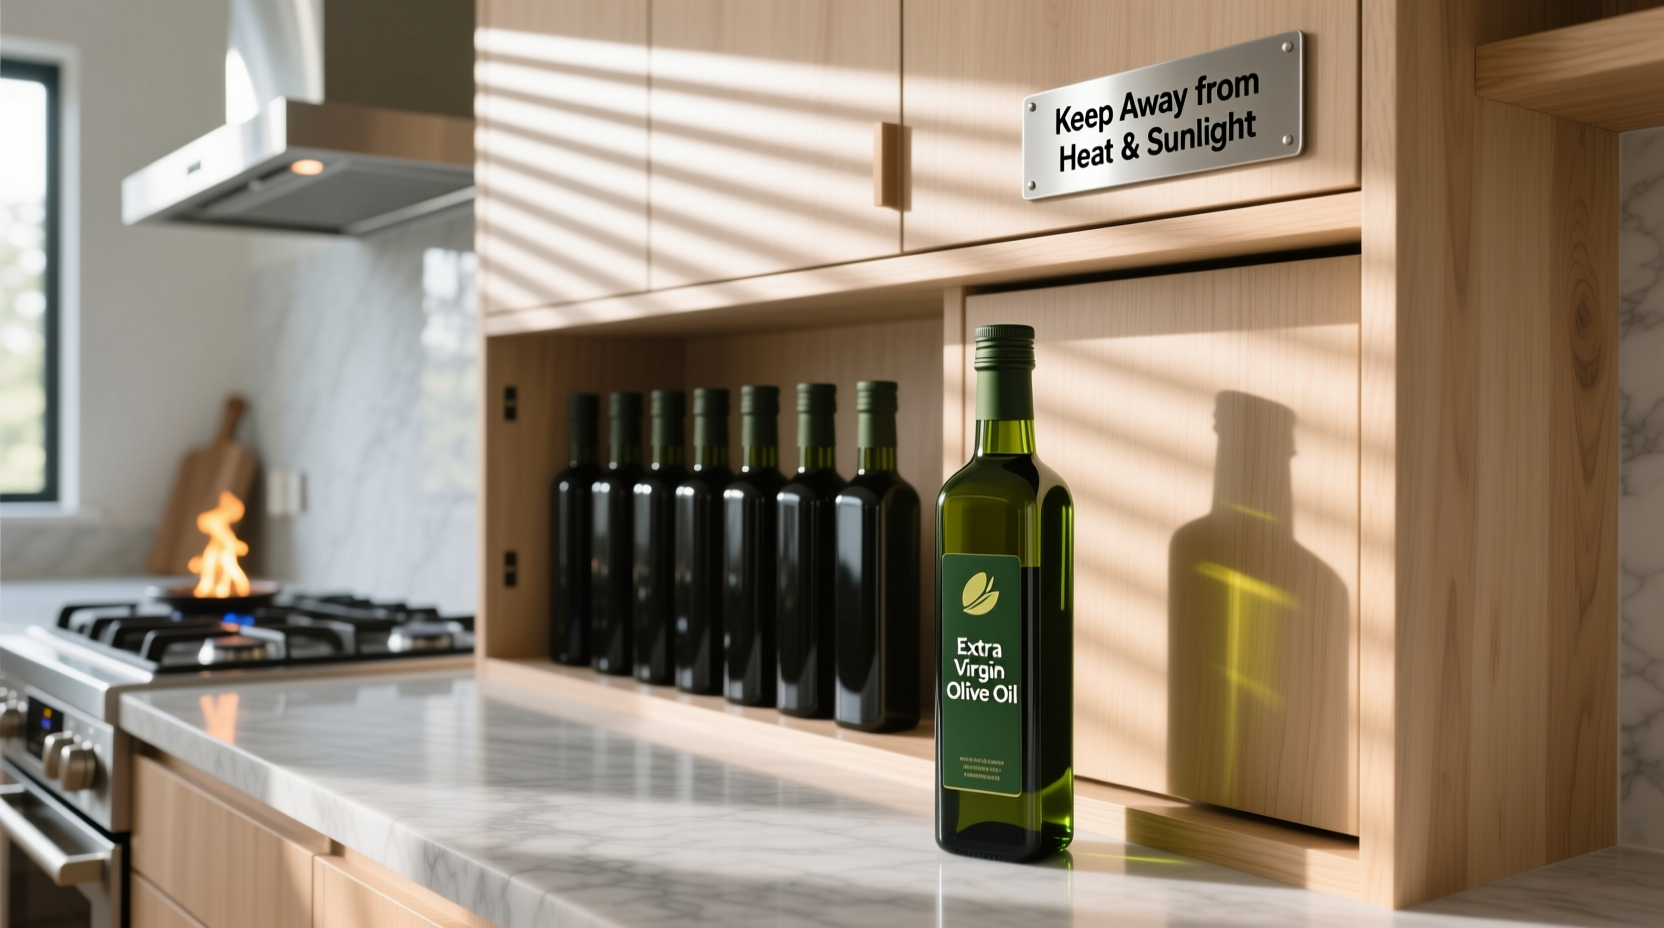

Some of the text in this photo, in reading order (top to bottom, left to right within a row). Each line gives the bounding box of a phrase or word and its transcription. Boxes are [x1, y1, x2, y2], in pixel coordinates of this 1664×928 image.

[1055, 72, 1259, 135] Keep Away from
[1059, 110, 1257, 172] Heat & Sunlight
[957, 637, 1002, 658] Extra
[954, 658, 1005, 683] Virgin
[946, 681, 1018, 704] Olive Oil
